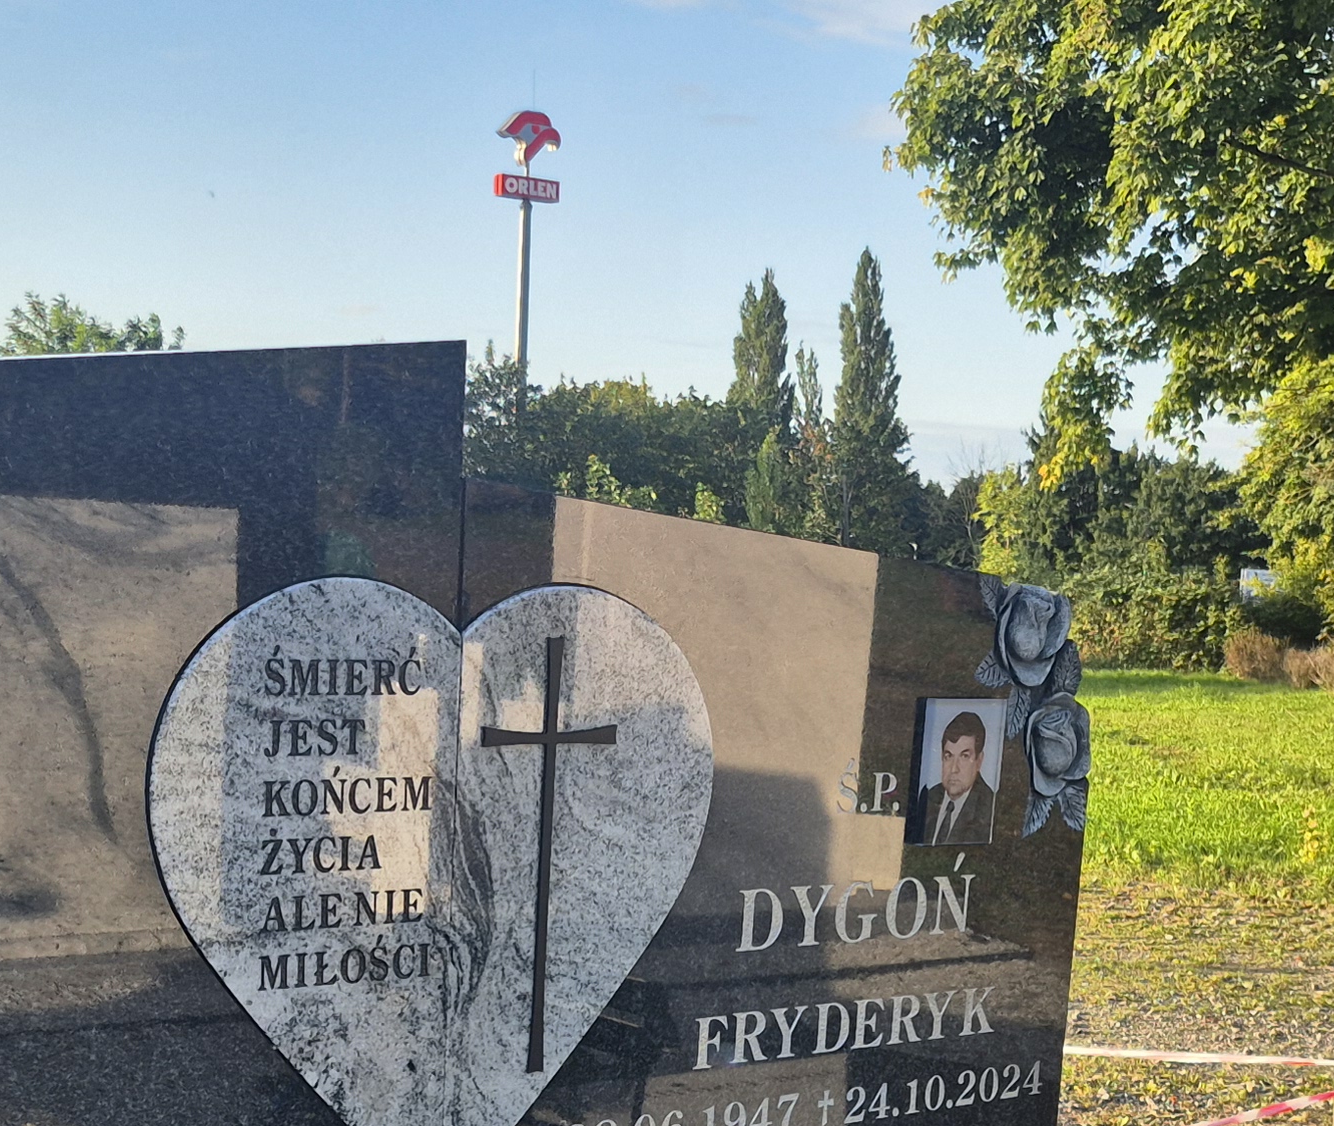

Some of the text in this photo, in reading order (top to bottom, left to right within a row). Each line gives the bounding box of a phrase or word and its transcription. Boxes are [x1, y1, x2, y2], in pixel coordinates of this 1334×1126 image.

[505, 177, 557, 199] ORLEN
[264, 644, 422, 697] ŚMIERĆ
[263, 718, 366, 758] JEST
[262, 765, 433, 818] KOŃCEM
[836, 757, 900, 815] Ś.P.
[259, 828, 382, 876] ŻYCIA
[734, 852, 976, 953] DYGOŃ
[258, 934, 431, 992] MIŁOŚCI
[691, 985, 996, 1071] FRYDERYK
[843, 1060, 1043, 1125] 24.10.2024
